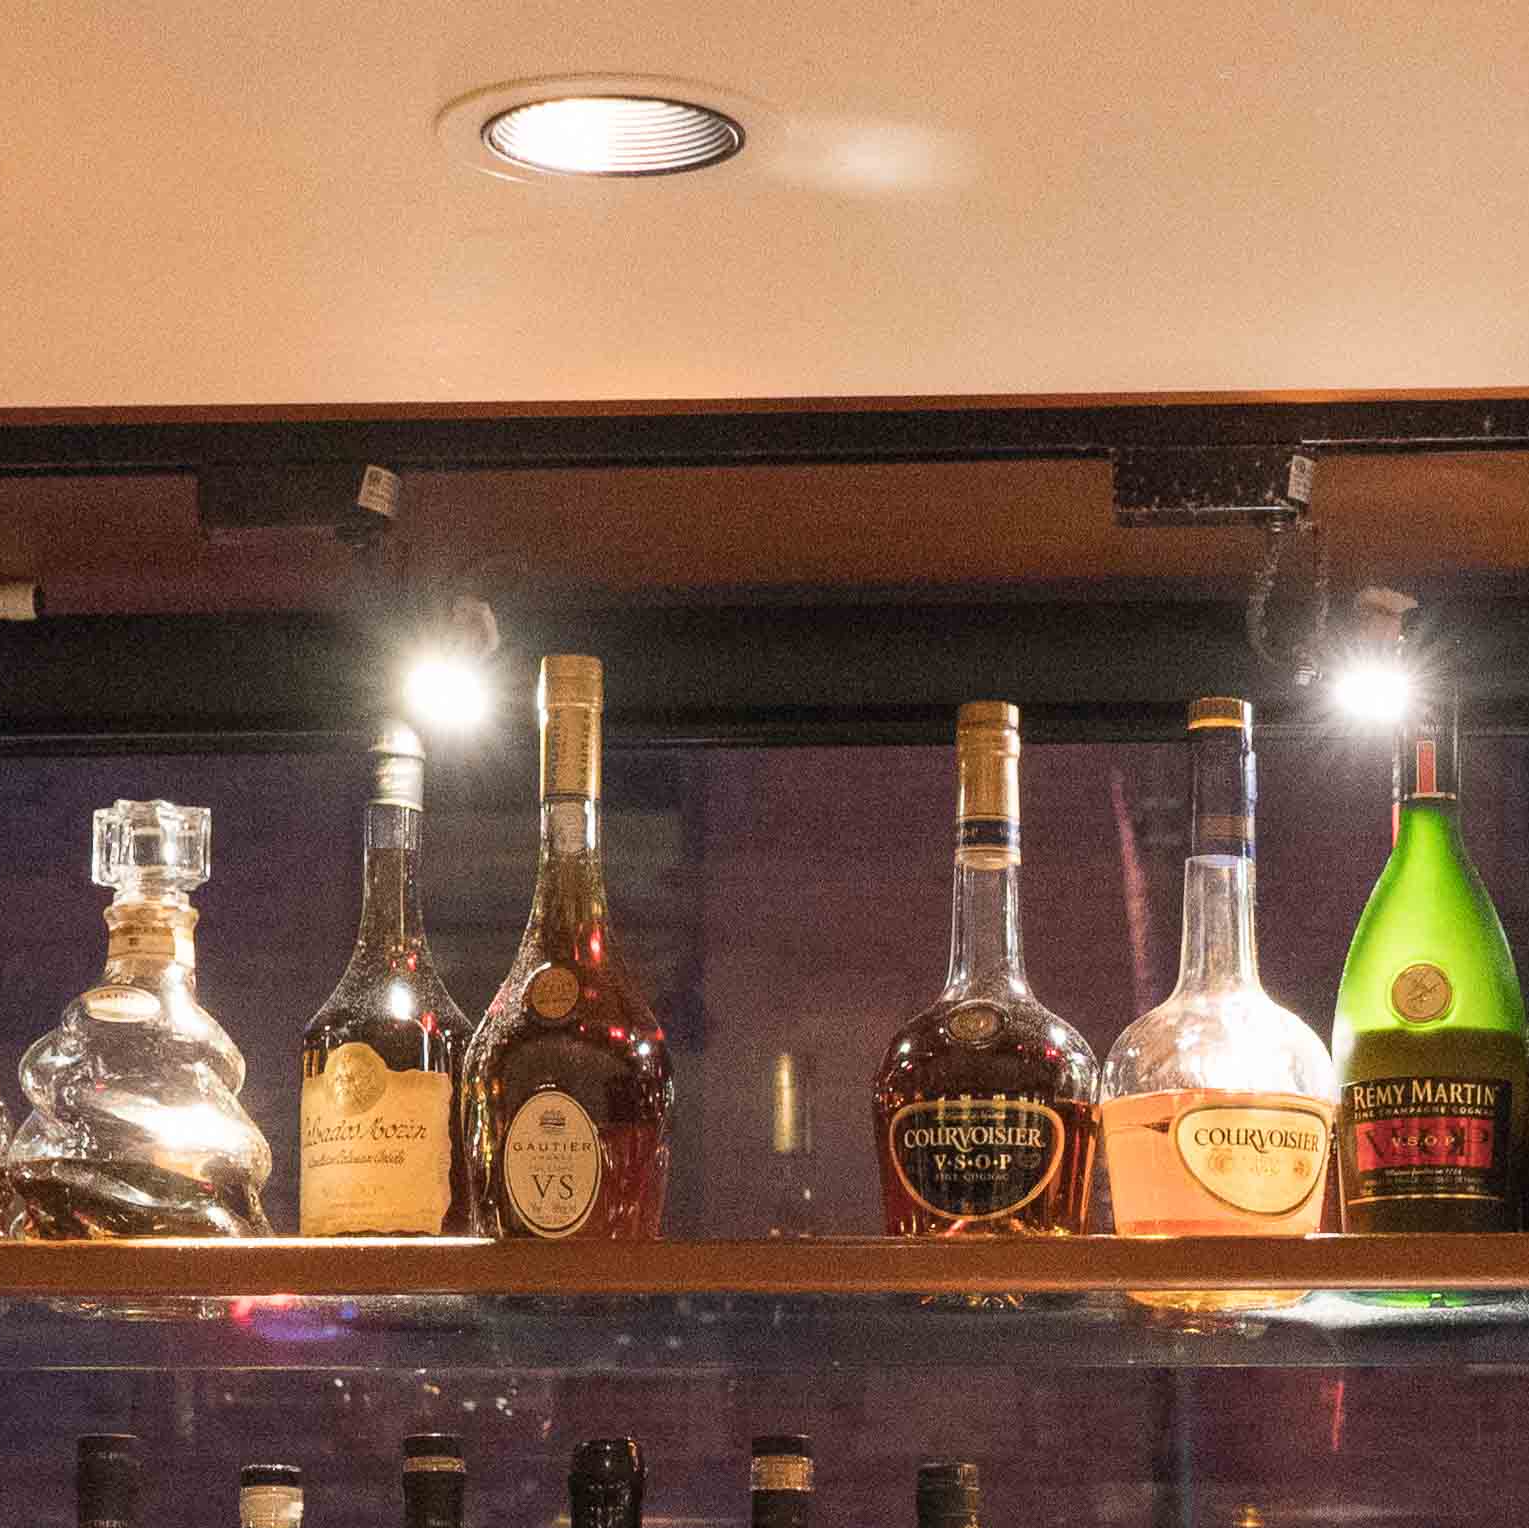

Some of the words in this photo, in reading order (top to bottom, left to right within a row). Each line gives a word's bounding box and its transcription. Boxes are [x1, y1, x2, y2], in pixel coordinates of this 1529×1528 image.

[1411, 1079, 1496, 1107] MARTIN
[512, 1141, 593, 1153] GAUTIER
[904, 1126, 1044, 1151] COURVOISIER
[1193, 1126, 1320, 1154] COURVOISIER
[531, 1173, 575, 1200] VS
